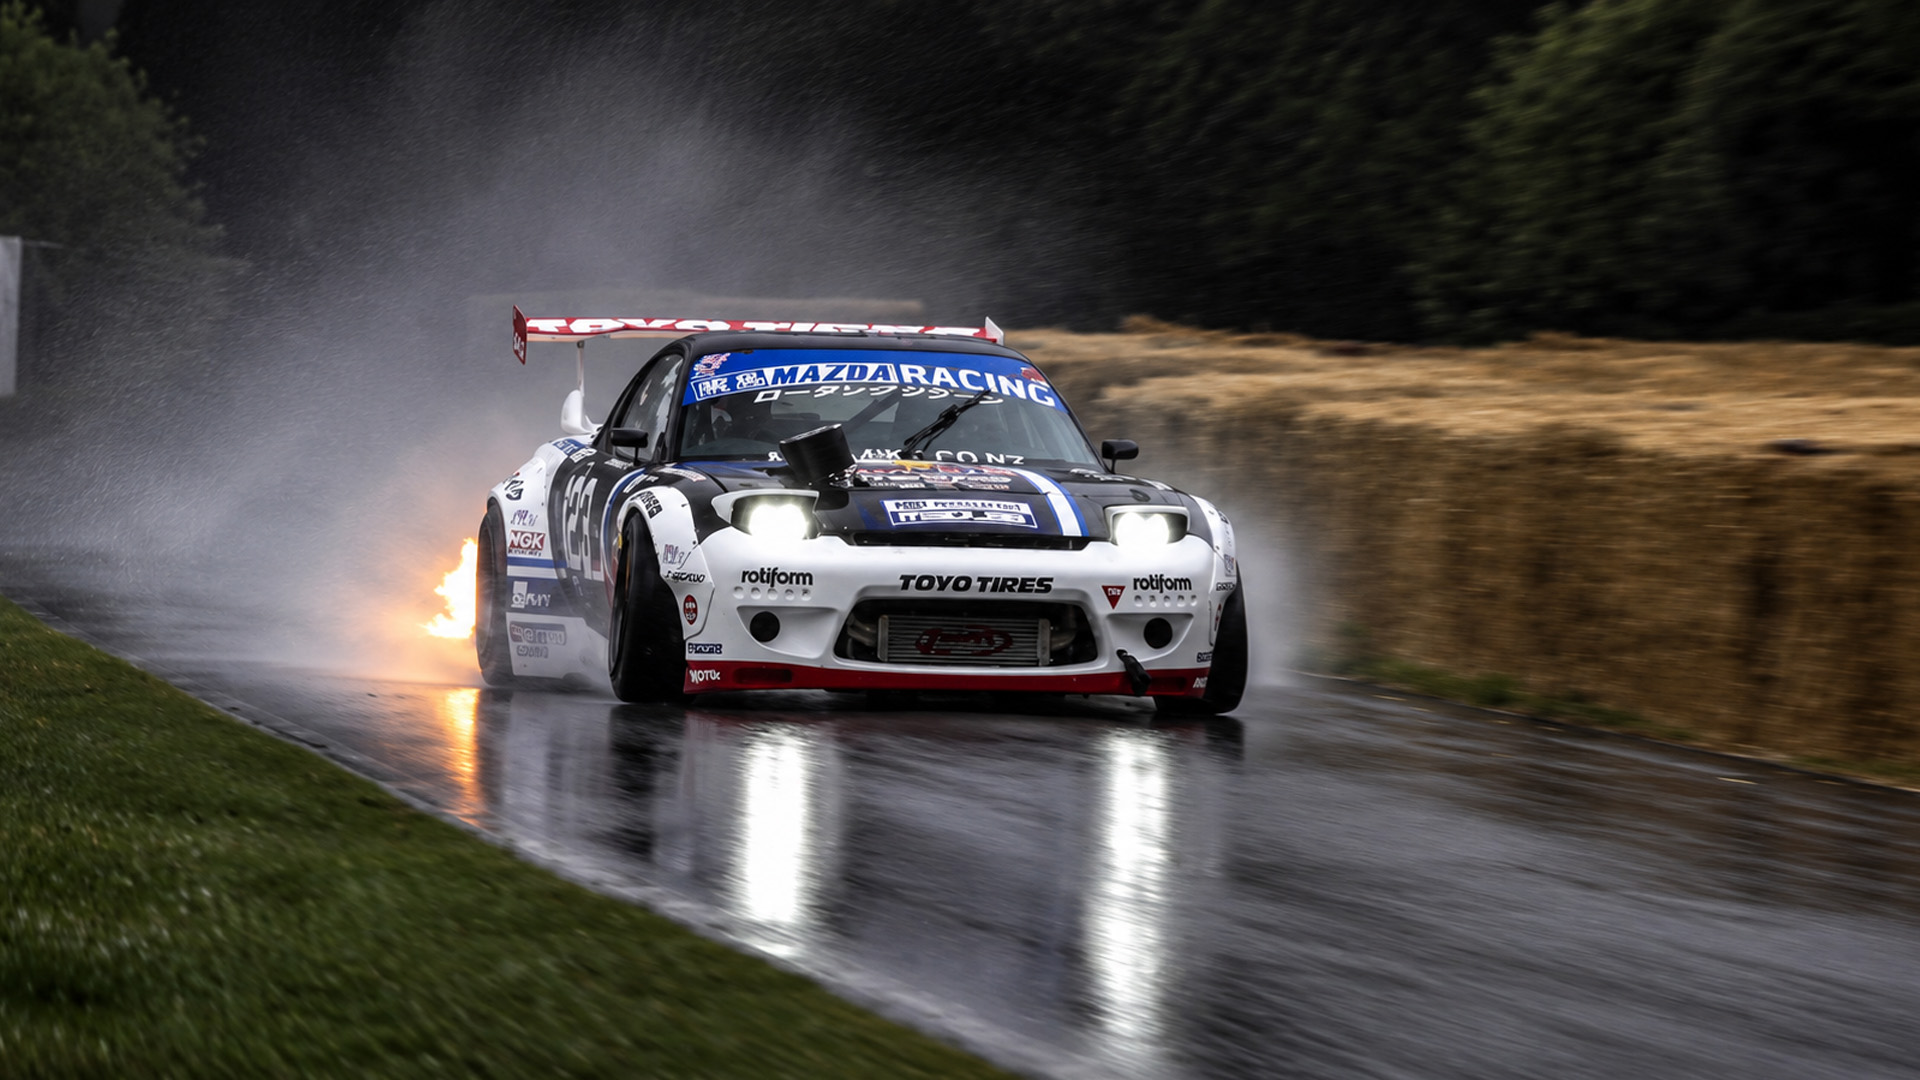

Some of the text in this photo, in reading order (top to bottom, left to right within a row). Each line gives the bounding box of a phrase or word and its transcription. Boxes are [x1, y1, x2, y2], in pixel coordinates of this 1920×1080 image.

[527, 319, 730, 335] TOYO
[770, 364, 893, 386] MAZDA
[900, 364, 1055, 407] RACING
[508, 531, 544, 550] NGK
[741, 567, 813, 588] rotiform
[899, 574, 1054, 594] TOYO TIRES
[1133, 574, 1192, 593] rotiform
